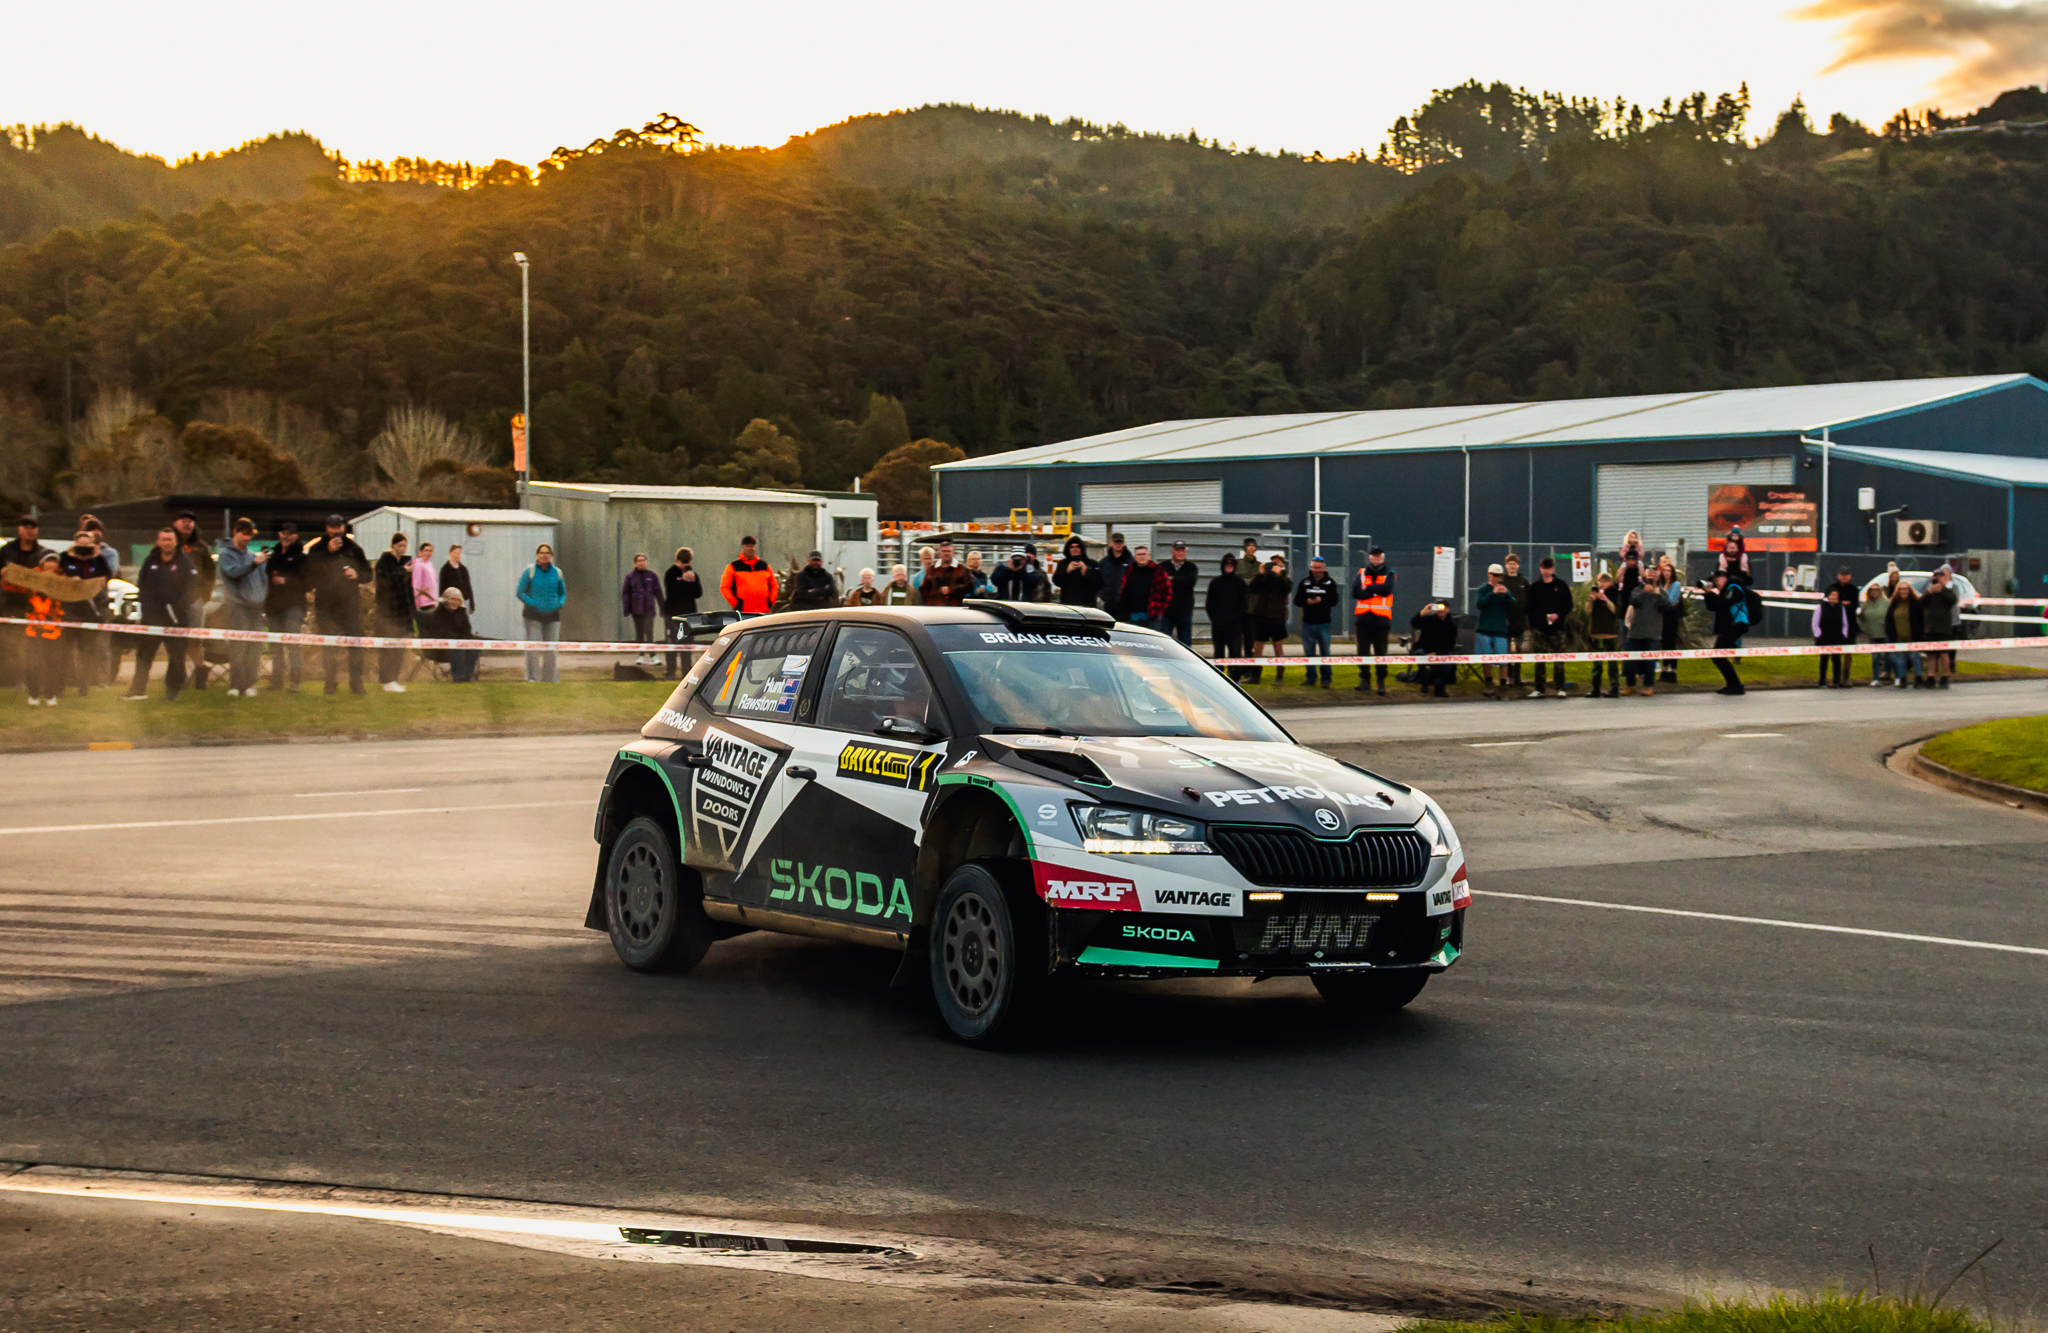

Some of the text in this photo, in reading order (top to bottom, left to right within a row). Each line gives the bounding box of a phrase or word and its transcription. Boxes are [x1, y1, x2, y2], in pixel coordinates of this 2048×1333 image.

[980, 632, 1046, 644] BRIAN
[1045, 634, 1112, 648] GREEN
[1428, 655, 1470, 663] CAUTION
[1695, 649, 1735, 657] CAUTION
[1748, 648, 1788, 656] CAUTION
[1801, 646, 1842, 654] CAUTION
[1854, 644, 1895, 652] CAUTION
[1908, 642, 1949, 651] CAUTION
[1961, 640, 2001, 648] CAUTION
[720, 651, 742, 701] 1
[763, 677, 785, 693] Hunt
[705, 733, 768, 780] VANTAGE
[840, 746, 887, 775] DAYLE
[701, 769, 750, 798] WINDOWS &
[918, 753, 937, 791] 1
[702, 798, 738, 821] DOORS
[1203, 786, 1392, 811] PETRONAS
[1047, 880, 1133, 902] MRF
[1155, 890, 1232, 907] VANTAGE
[1260, 915, 1381, 948] HUNT
